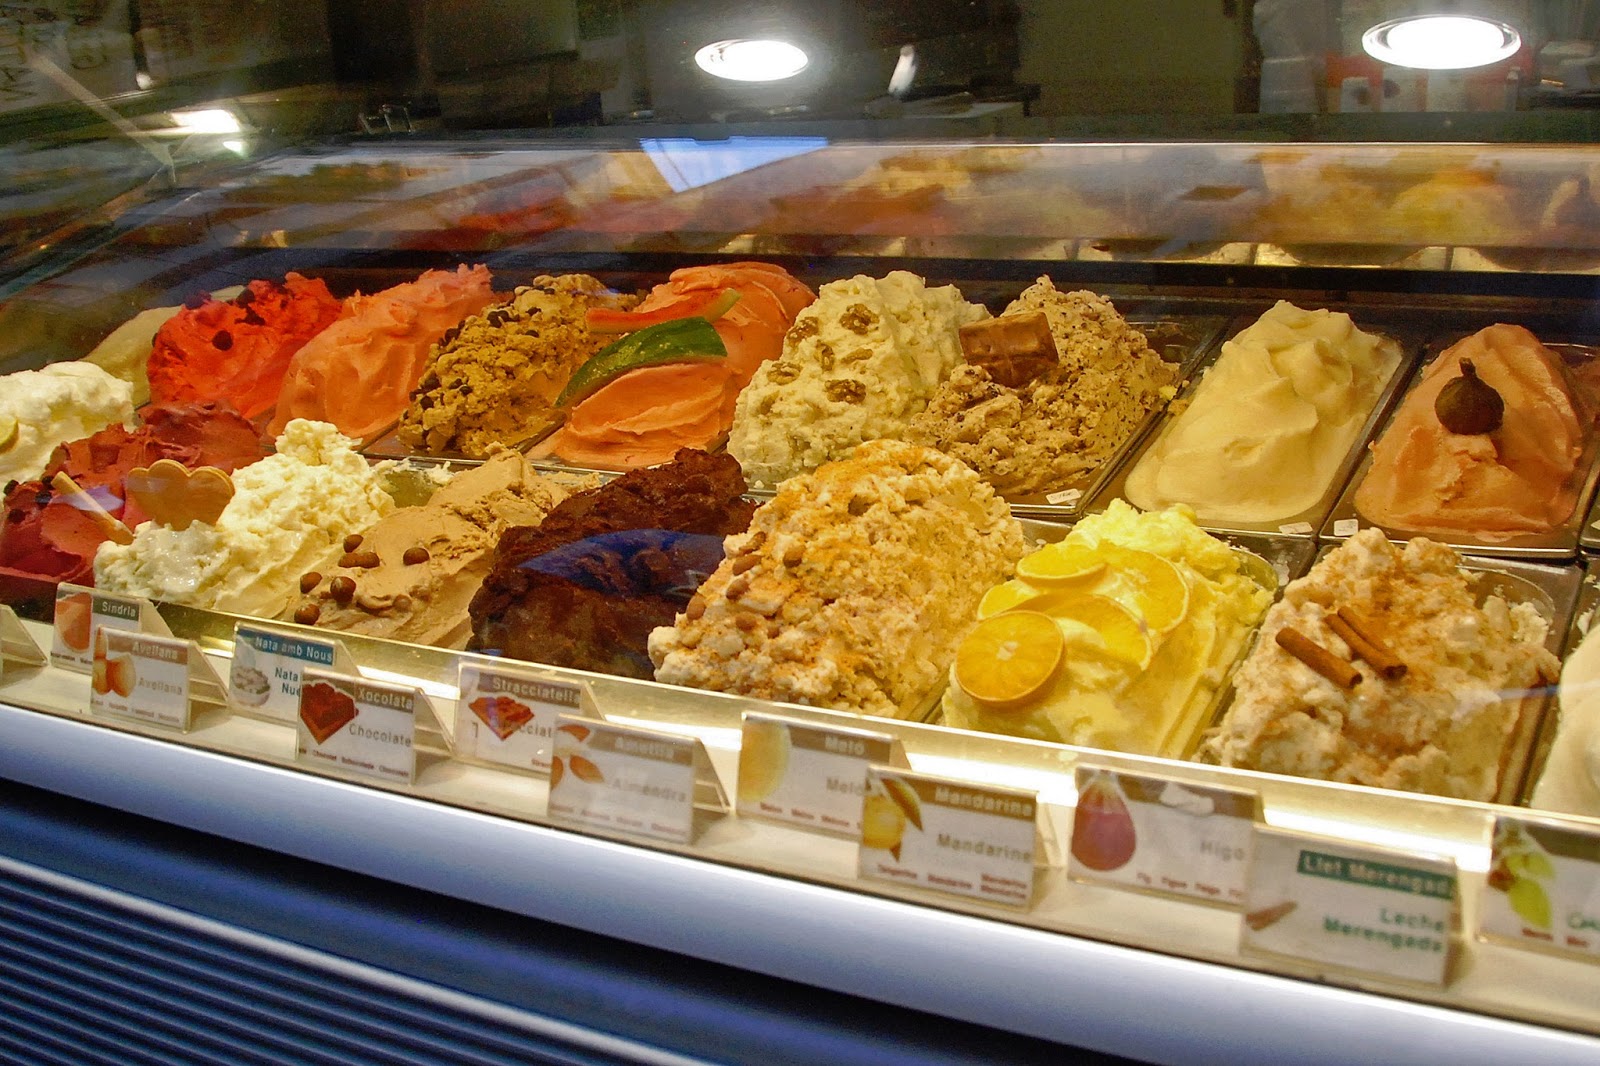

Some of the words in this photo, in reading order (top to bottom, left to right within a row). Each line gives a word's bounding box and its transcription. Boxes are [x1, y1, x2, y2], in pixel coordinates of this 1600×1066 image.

[255, 636, 278, 651] Nata
[281, 643, 303, 656] amb
[306, 646, 333, 662] Nous
[275, 667, 299, 682] Nata
[349, 723, 411, 747] Chocolate
